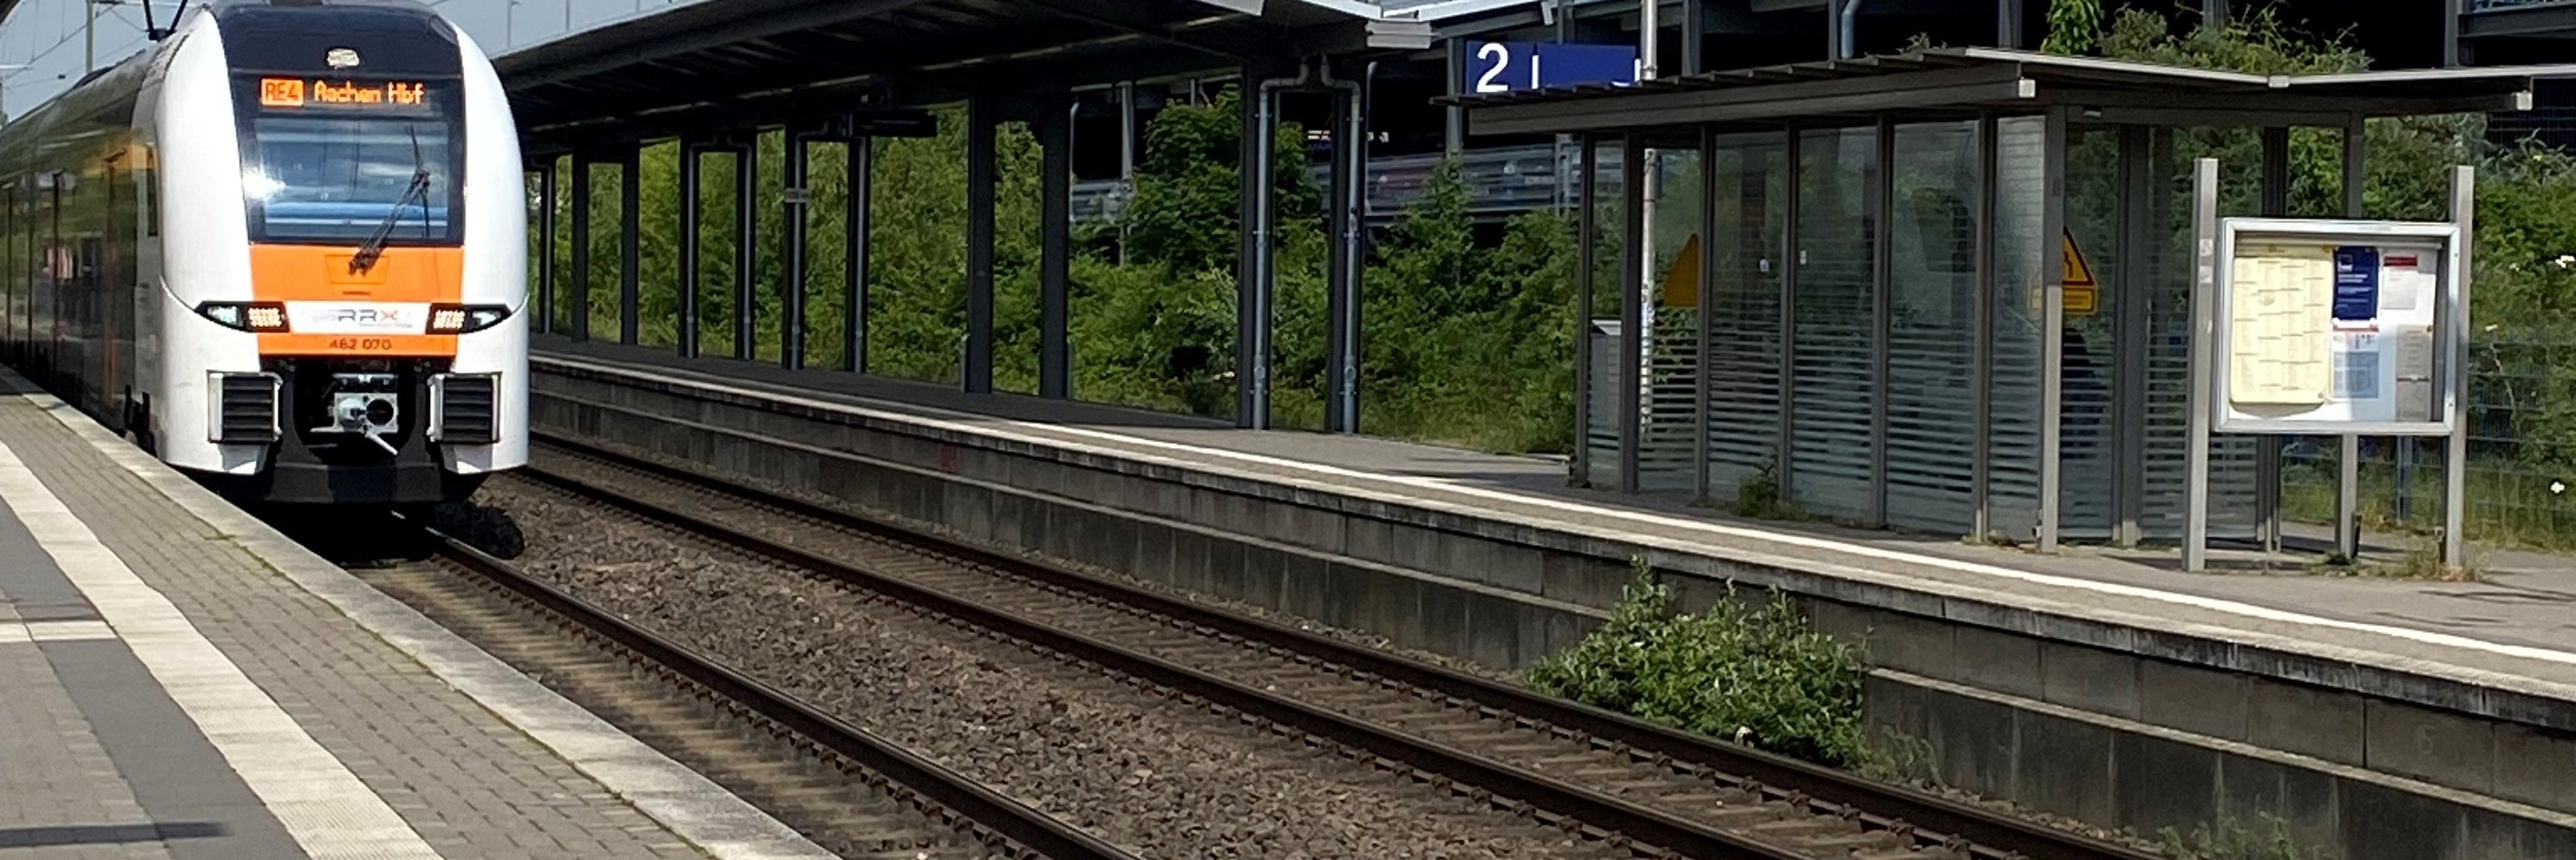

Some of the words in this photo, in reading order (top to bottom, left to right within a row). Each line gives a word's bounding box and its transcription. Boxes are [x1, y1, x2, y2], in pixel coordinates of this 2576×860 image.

[1477, 42, 1508, 93] 2
[264, 80, 301, 102] RE4
[314, 80, 381, 103] Aachen
[388, 81, 424, 104] Hbf
[337, 309, 398, 322] RRX
